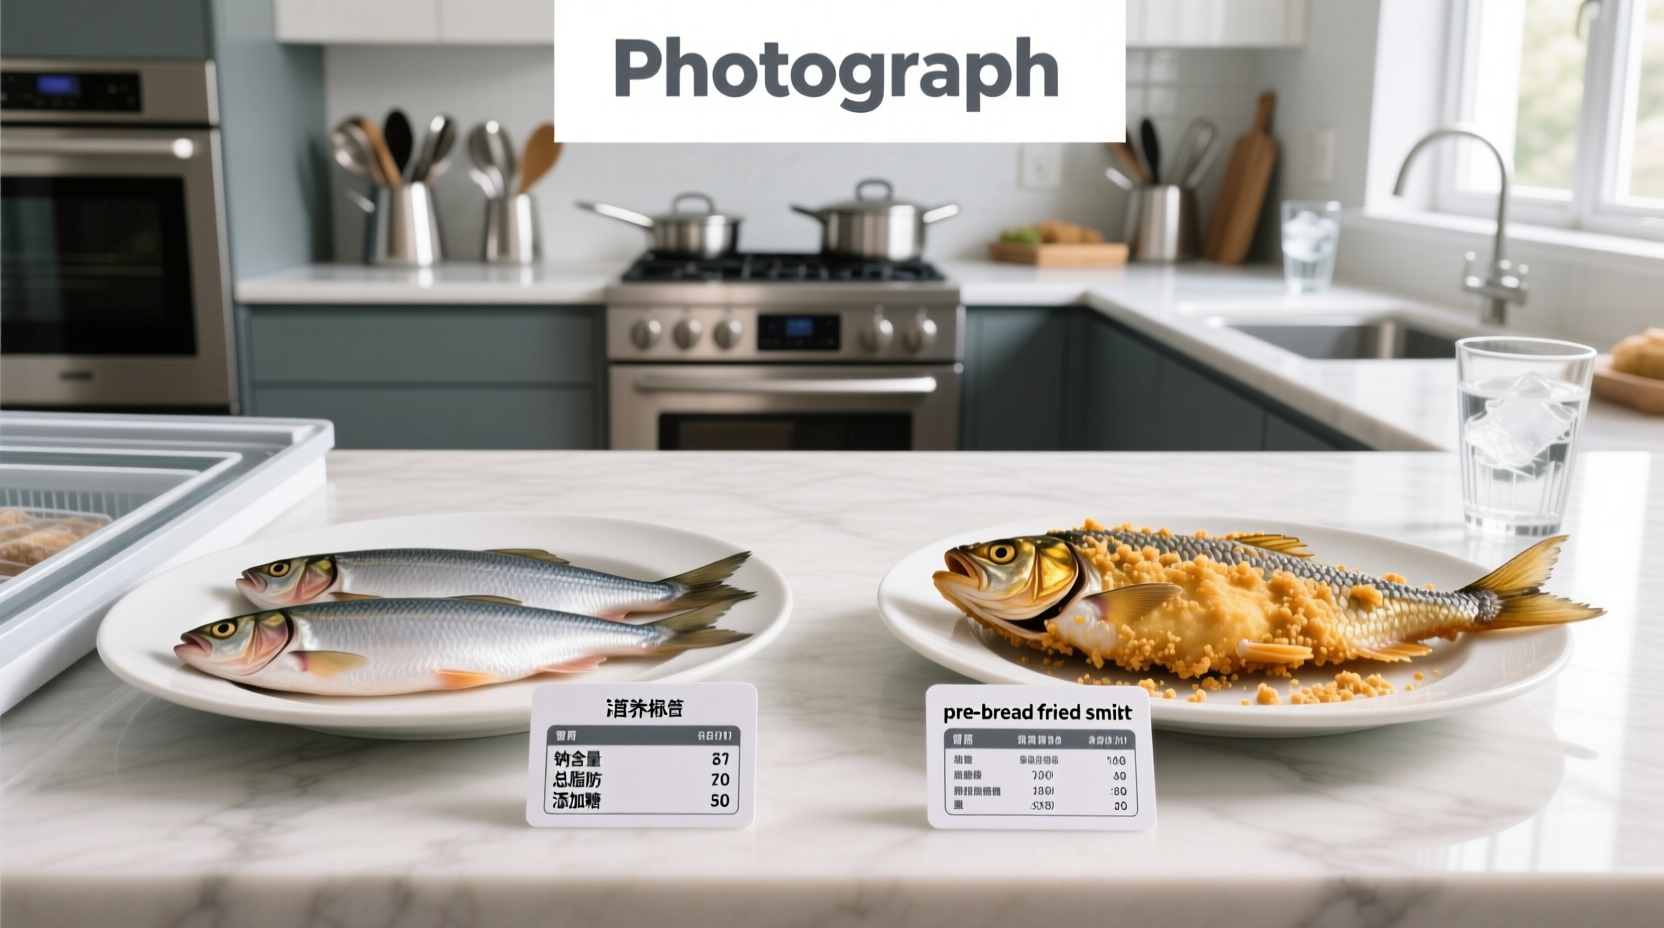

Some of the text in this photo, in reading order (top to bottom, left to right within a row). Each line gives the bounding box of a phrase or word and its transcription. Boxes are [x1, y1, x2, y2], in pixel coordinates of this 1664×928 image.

[944, 703, 1133, 723] pre-bread fried smitt
[710, 793, 730, 808] 50
